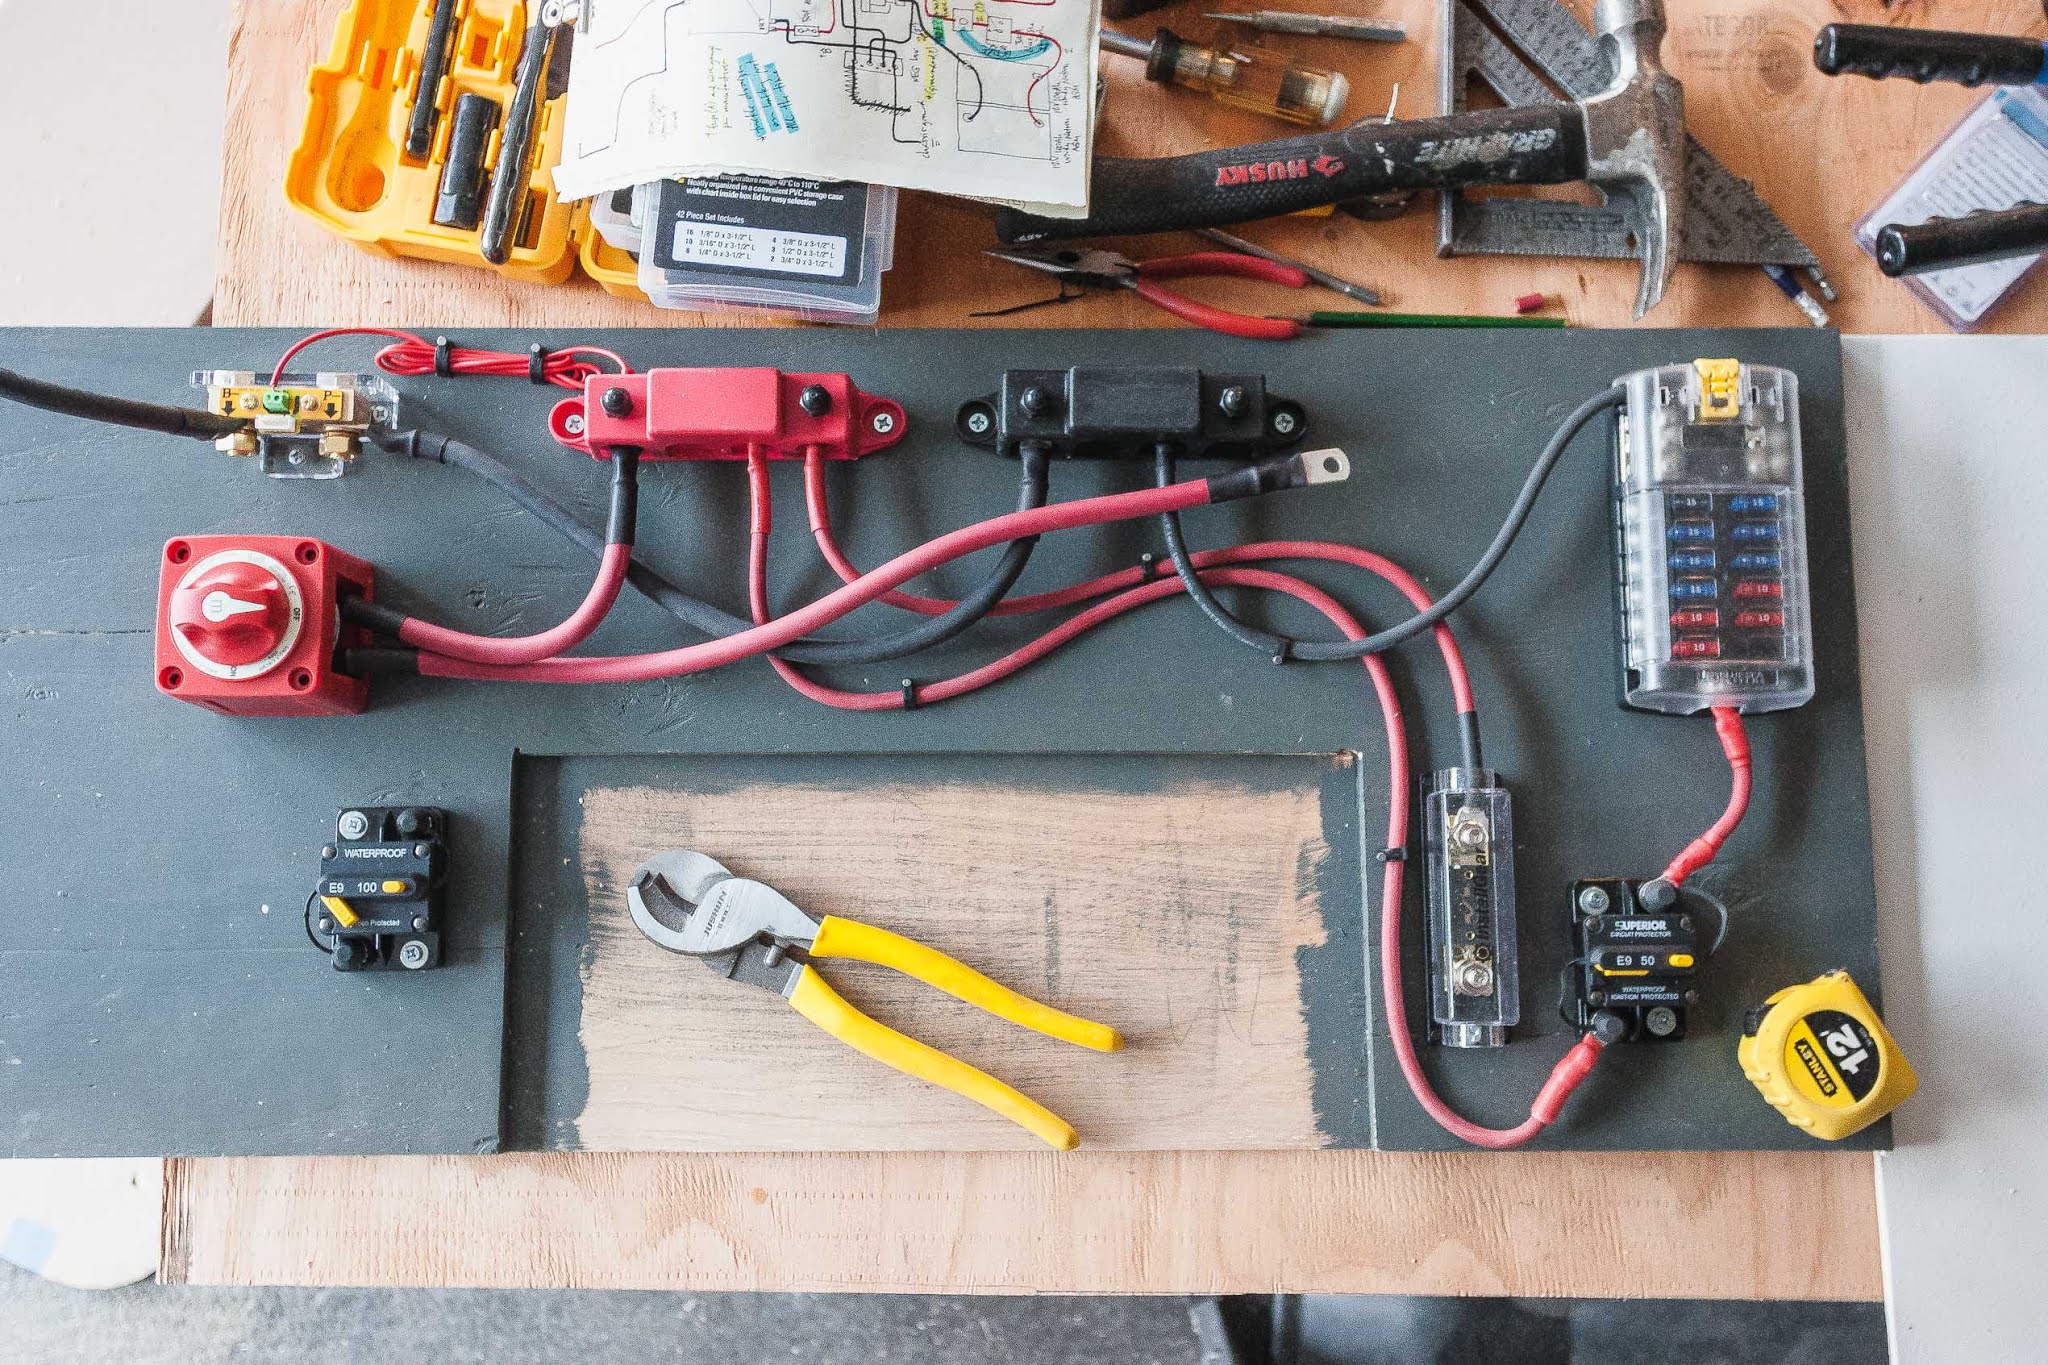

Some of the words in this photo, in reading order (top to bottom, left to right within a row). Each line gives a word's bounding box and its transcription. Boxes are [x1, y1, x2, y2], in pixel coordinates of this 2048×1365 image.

[1215, 159, 1308, 186] HUSKY
[759, 178, 776, 186] range
[687, 179, 708, 188] Neatly
[753, 185, 788, 195] convenient
[789, 188, 803, 197] PVC
[803, 190, 827, 200] storage
[702, 188, 719, 197] chart
[720, 190, 738, 198] inside
[771, 196, 787, 204] easy
[787, 197, 816, 206] selection
[676, 210, 685, 218] 42
[686, 211, 703, 220] Piece
[705, 213, 716, 221] Set
[717, 214, 744, 224] Includes
[1690, 614, 1702, 622] 10
[1693, 643, 1705, 651] 10
[230, 665, 237, 676] ON
[344, 848, 406, 858] WATERPROOF
[329, 883, 344, 893] E9
[358, 882, 377, 893] 100
[1615, 920, 1667, 931] SUPERIOR
[1616, 955, 1632, 966] E9
[1640, 955, 1655, 966] 50
[1798, 1044, 1834, 1093] STANLEY
